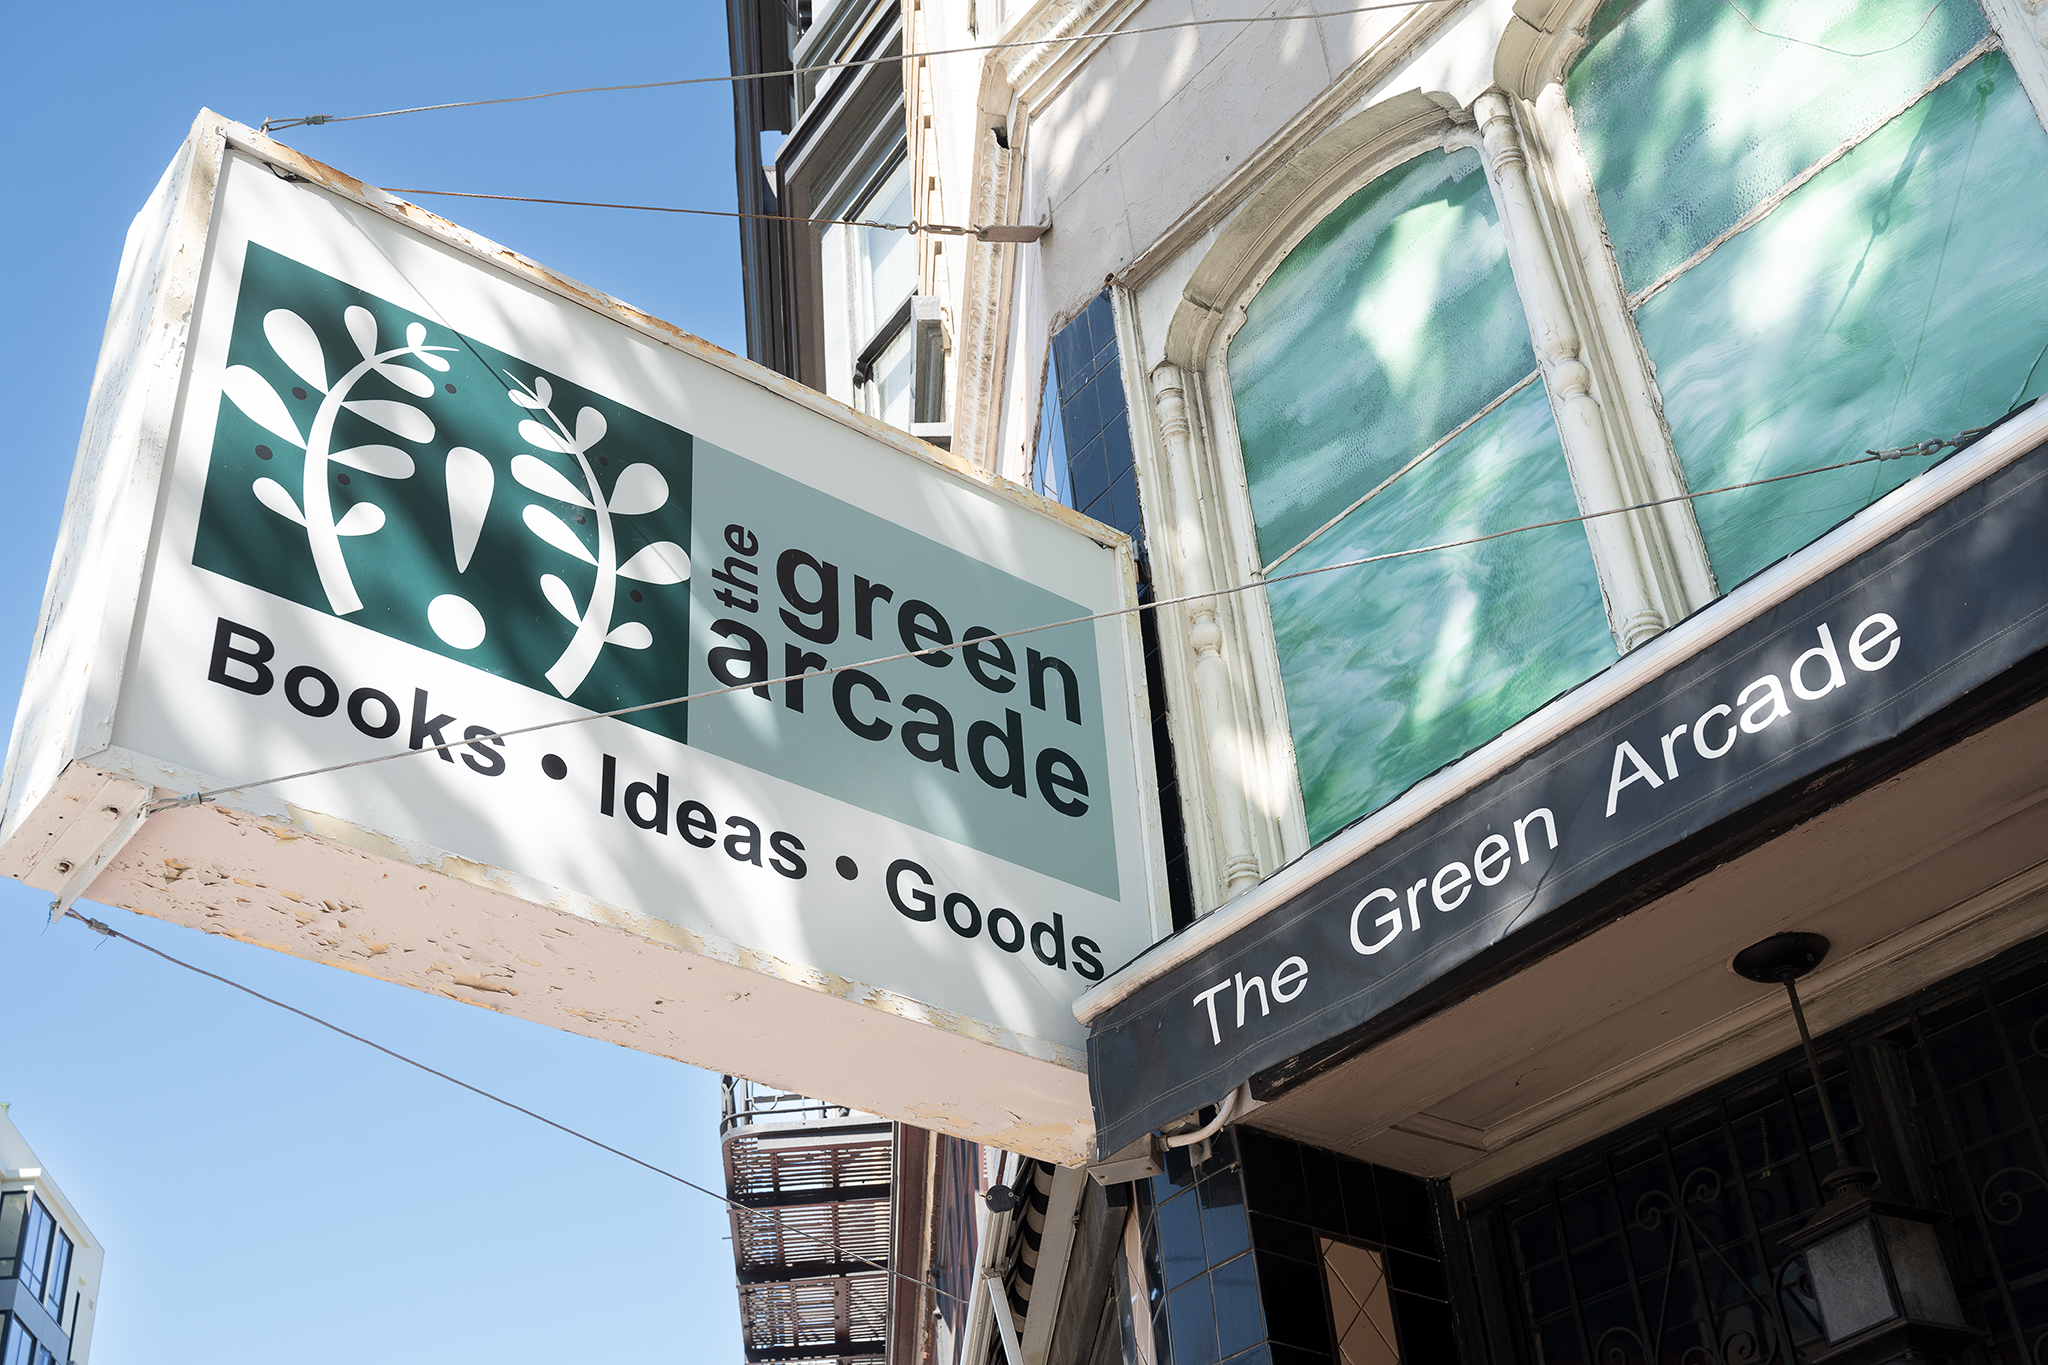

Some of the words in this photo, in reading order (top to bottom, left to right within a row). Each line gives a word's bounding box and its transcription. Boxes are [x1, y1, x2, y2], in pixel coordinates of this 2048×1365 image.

[712, 523, 759, 613] the
[776, 548, 1082, 726] green
[208, 617, 506, 777] Books
[600, 753, 807, 880] Ideas
[886, 858, 1104, 981] Goods
[707, 618, 1090, 818] arcade
[1192, 955, 1309, 1046] The
[1349, 805, 1558, 956] Green
[1605, 612, 1901, 818] Arcade
